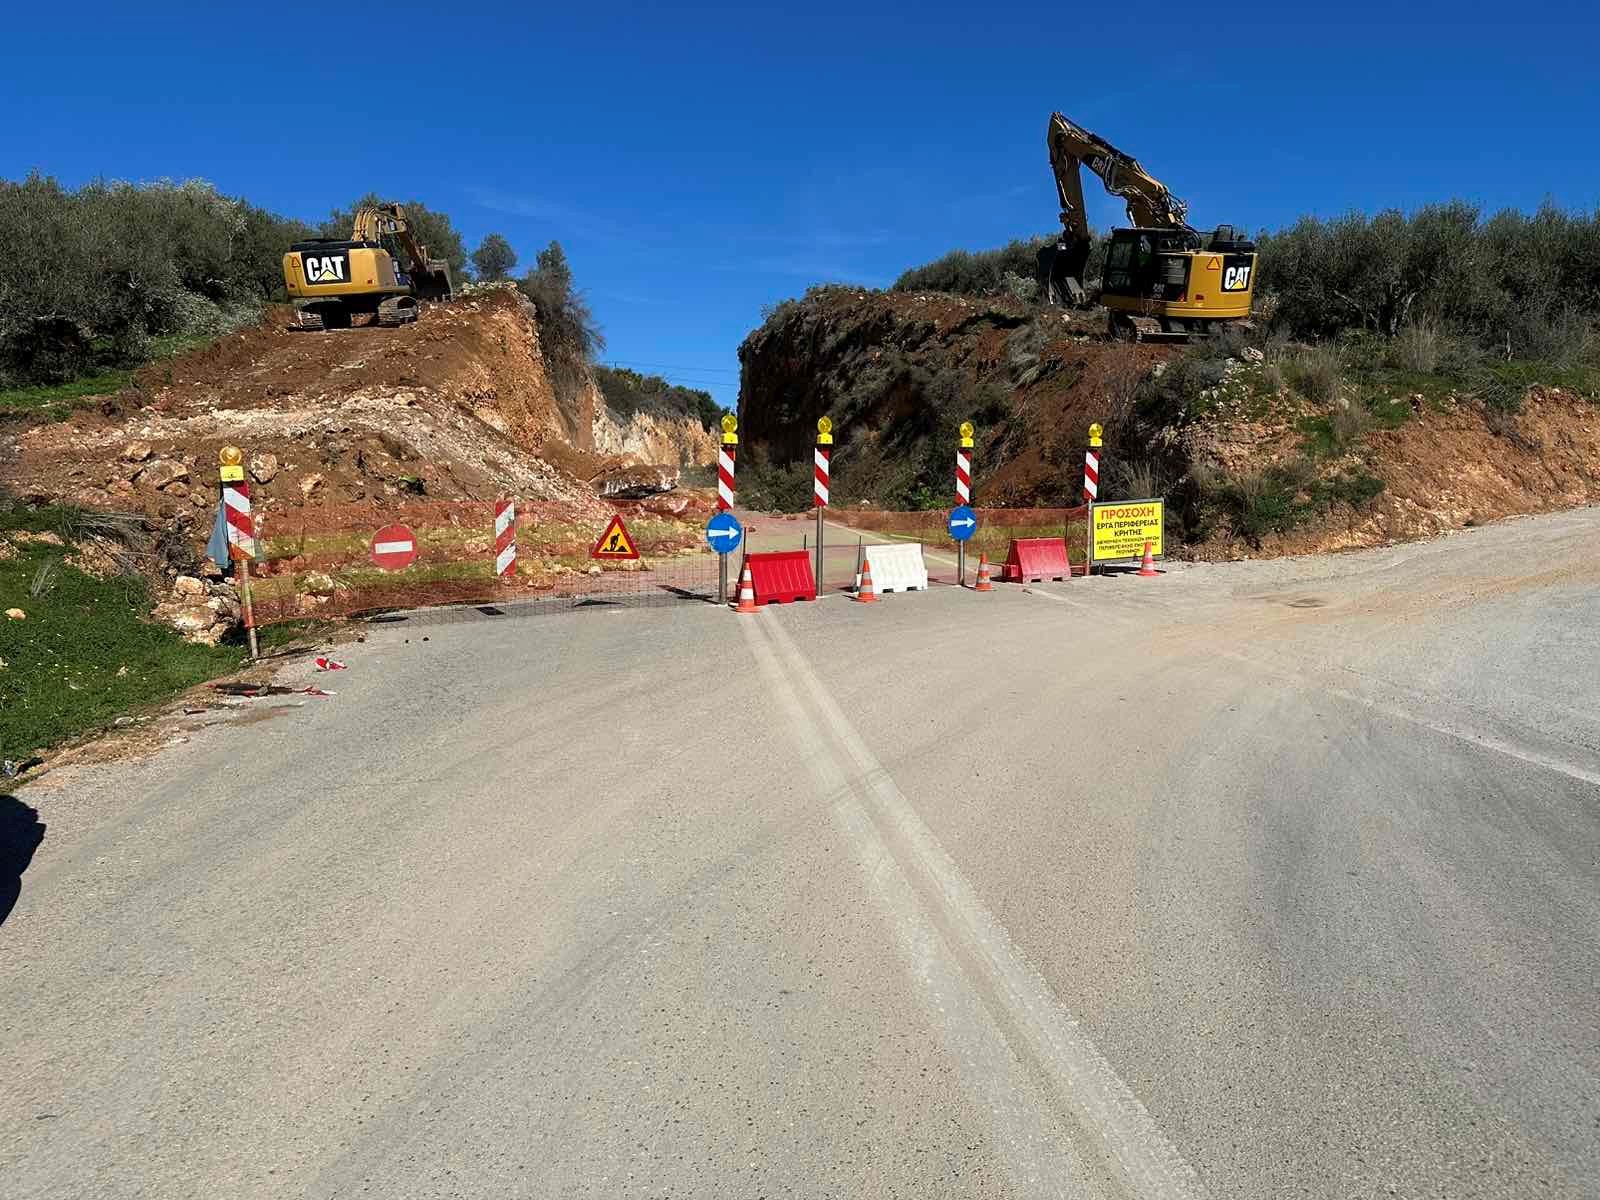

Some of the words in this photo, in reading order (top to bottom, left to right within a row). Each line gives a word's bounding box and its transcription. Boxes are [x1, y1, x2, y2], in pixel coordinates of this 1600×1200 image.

[306, 256, 345, 282] CAT
[1224, 266, 1250, 290] CAT
[1101, 507, 1155, 520] ΠΡΟΣΟΧΗ
[1096, 522, 1114, 530] ΕΡΓΑ
[1114, 519, 1159, 529] ΠΕΡΙΦΕΡΕΙΑΣ
[1114, 528, 1143, 537] ΚΡΗΤΗΣ
